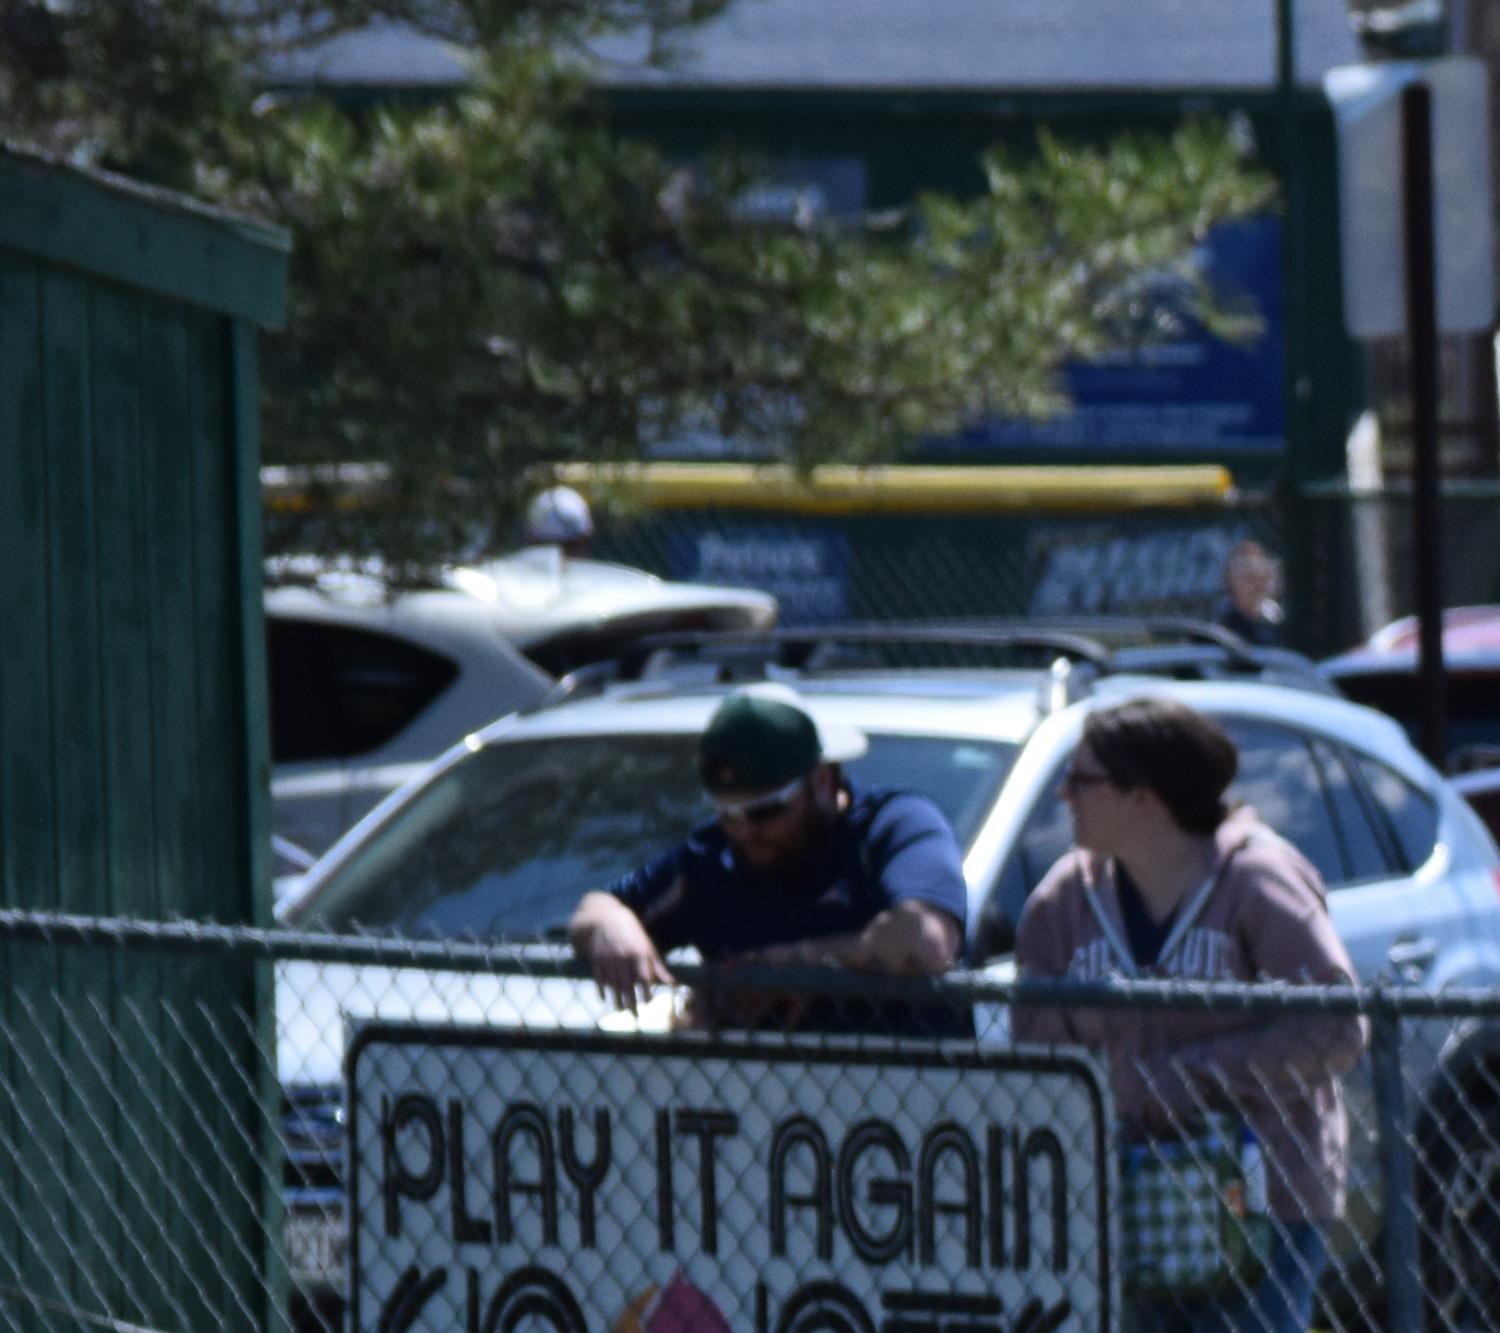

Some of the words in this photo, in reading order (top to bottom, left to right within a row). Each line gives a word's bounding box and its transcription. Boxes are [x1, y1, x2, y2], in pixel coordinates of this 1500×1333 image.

[383, 1094, 610, 1249] PLAY
[657, 1107, 738, 1256] IT
[769, 1113, 1068, 1273] AGAIN
